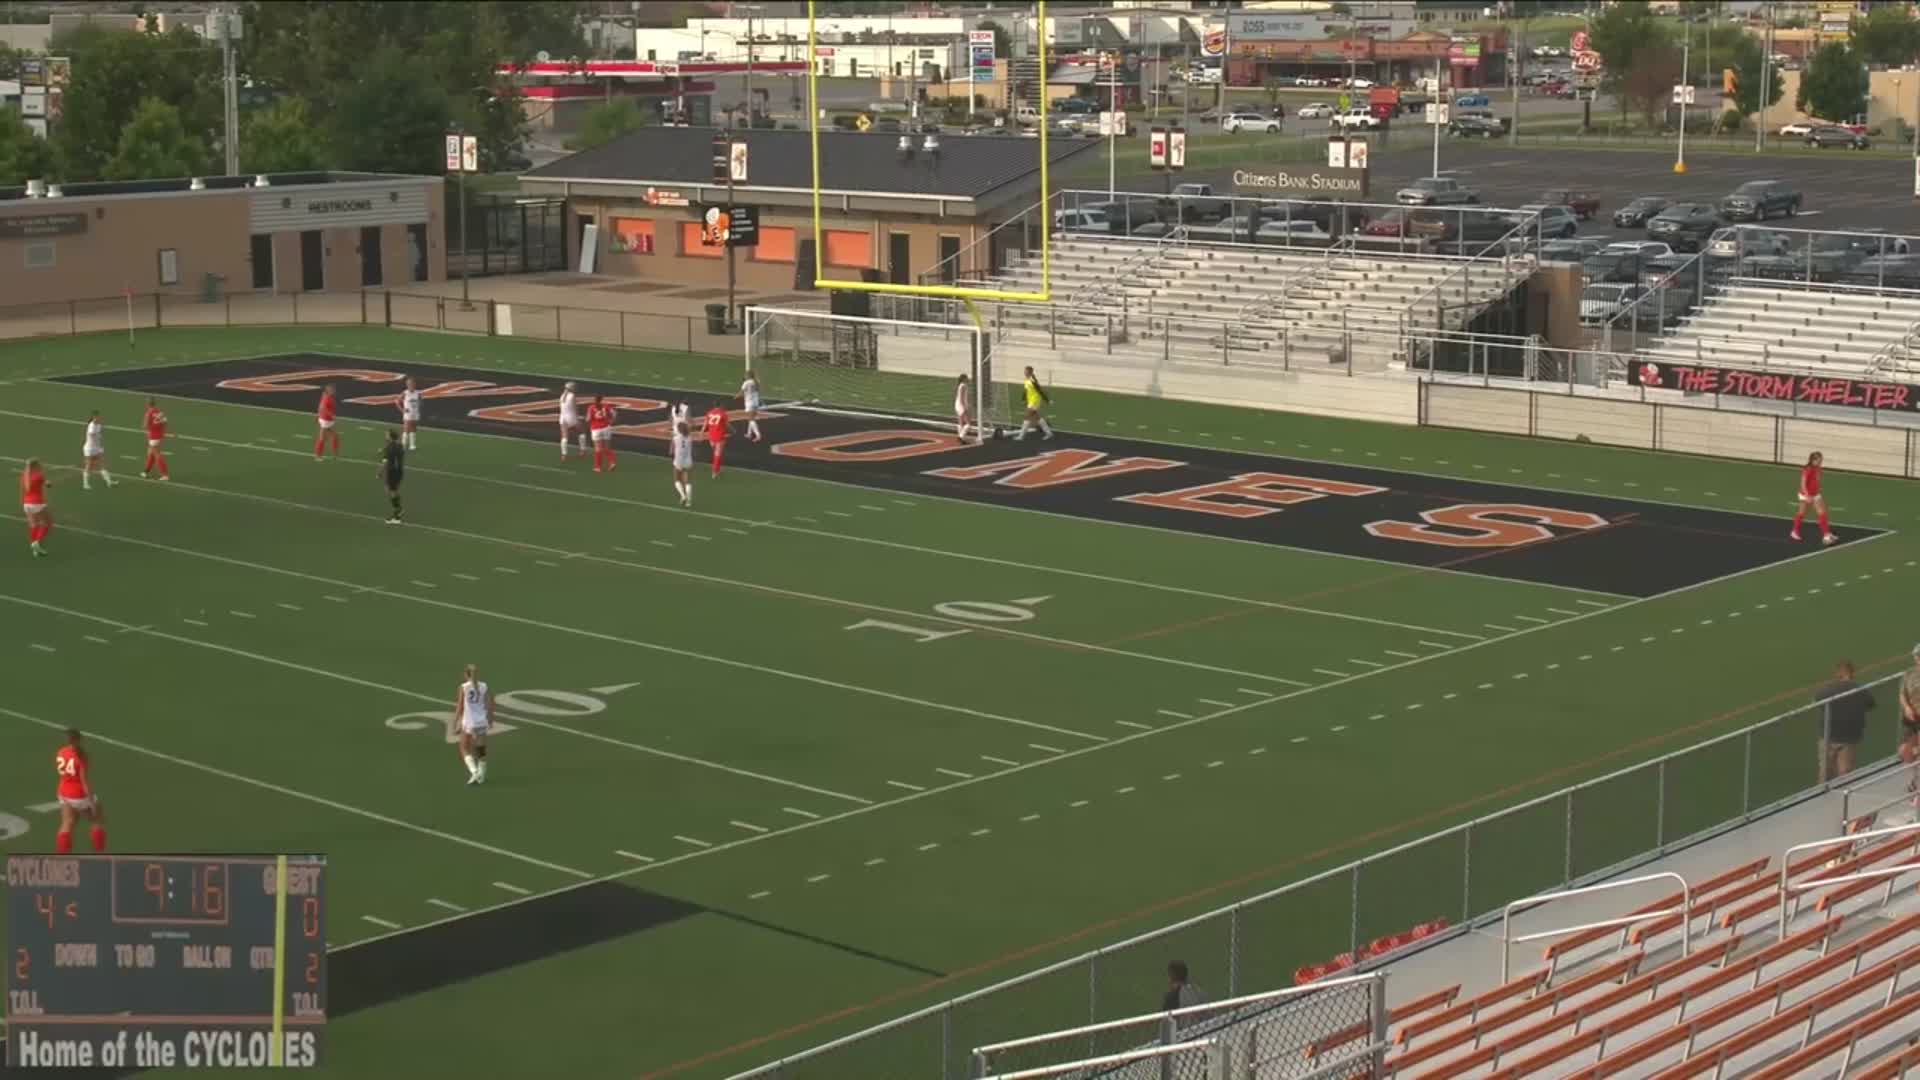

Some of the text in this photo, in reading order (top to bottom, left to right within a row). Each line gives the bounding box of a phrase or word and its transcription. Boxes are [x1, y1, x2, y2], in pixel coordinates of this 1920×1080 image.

[1233, 169, 1361, 192] Citizens BANK STADIUM
[1674, 367, 1908, 408] THE STORM SHELTER
[56, 756, 76, 776] 24
